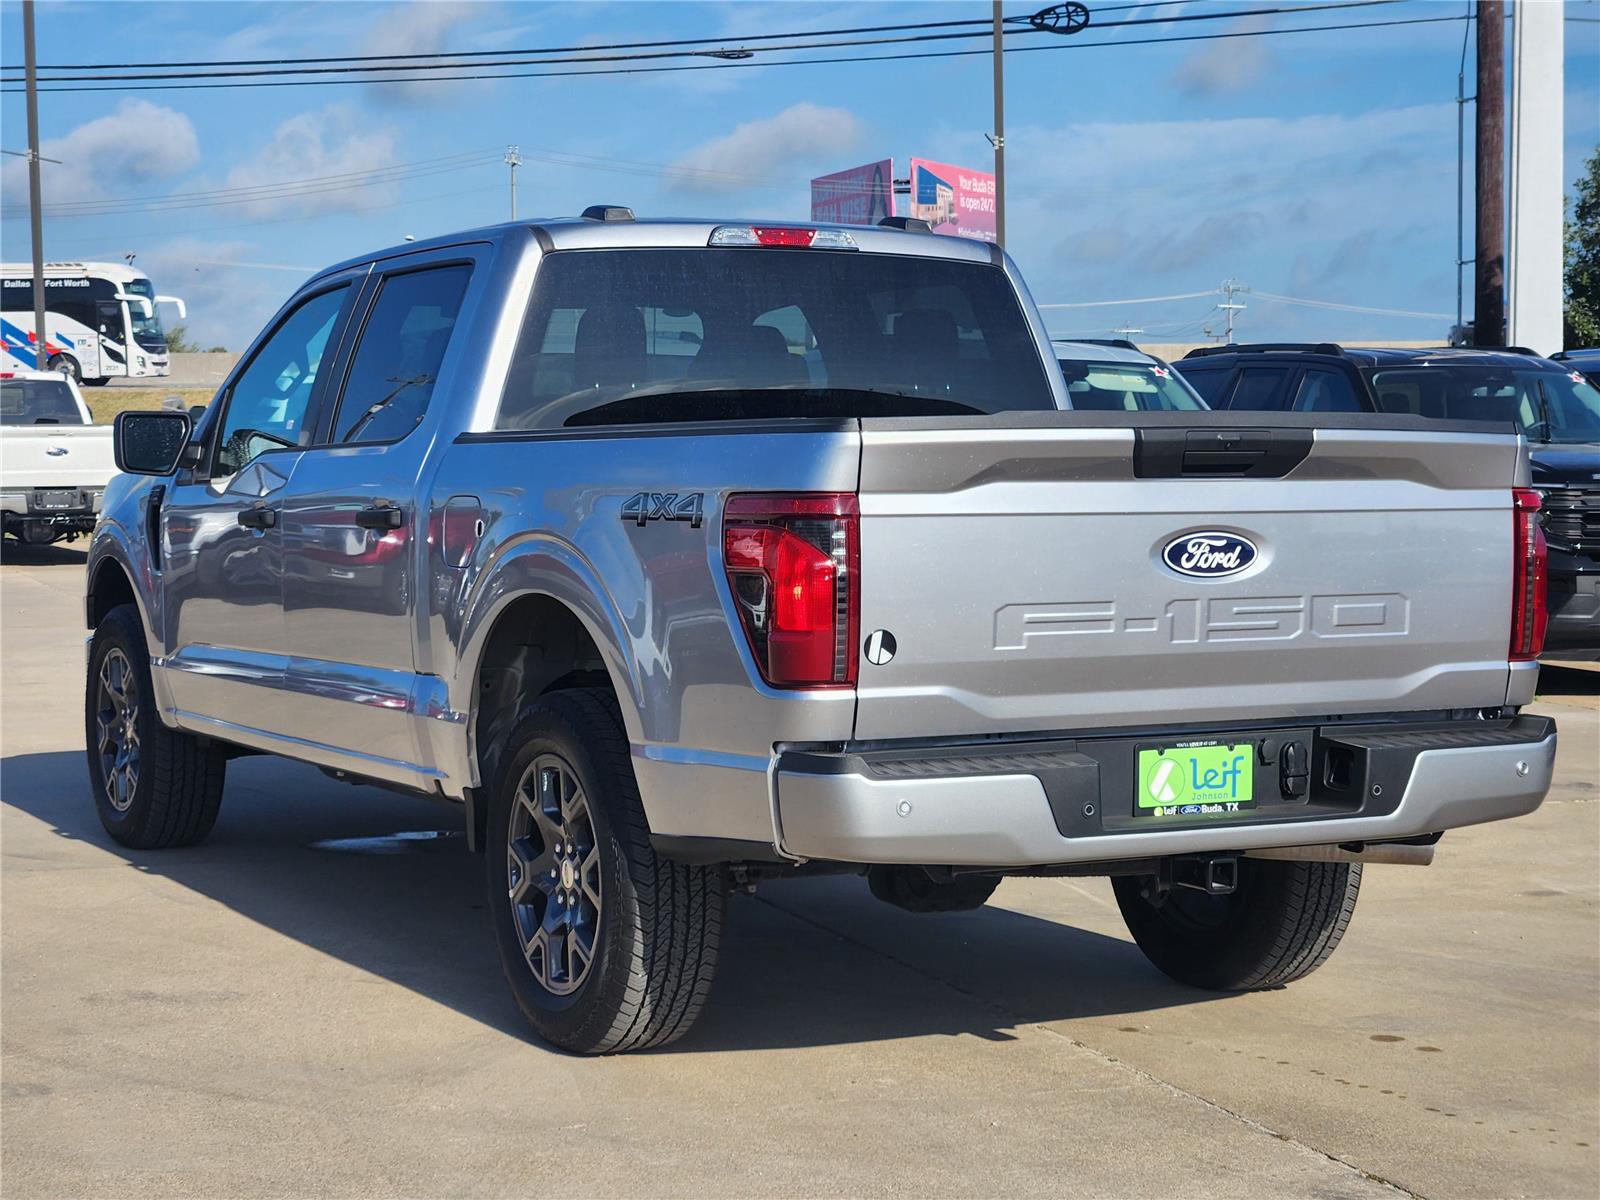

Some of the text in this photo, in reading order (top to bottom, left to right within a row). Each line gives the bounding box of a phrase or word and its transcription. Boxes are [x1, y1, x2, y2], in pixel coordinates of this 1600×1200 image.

[959, 174, 971, 190] Your
[972, 177, 987, 193] Buda
[960, 192, 965, 208] is
[966, 197, 980, 212] open
[4, 280, 31, 288] Dallas
[44, 279, 90, 288] Fort Worth
[1181, 538, 1241, 570] Ford
[993, 593, 1410, 651] F-150
[1192, 793, 1228, 801] Johnson
[1226, 803, 1239, 811] TX
